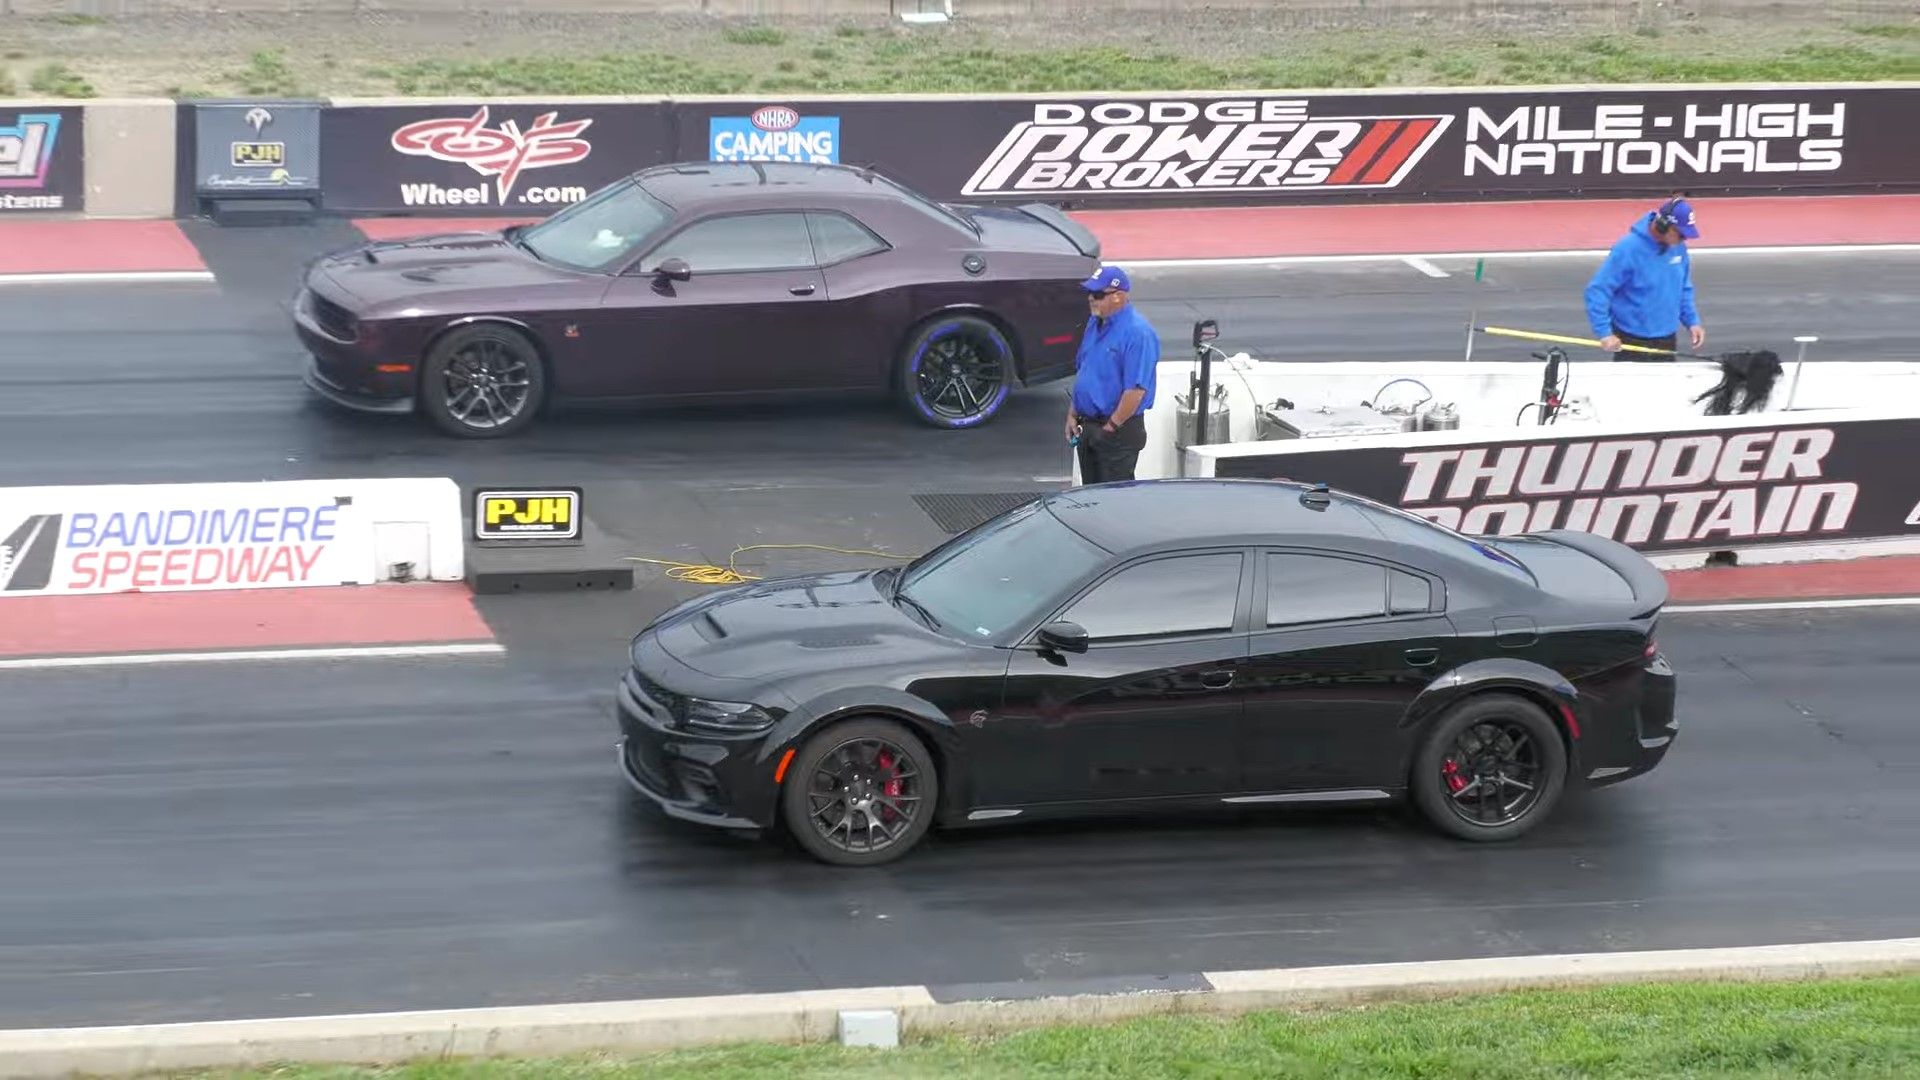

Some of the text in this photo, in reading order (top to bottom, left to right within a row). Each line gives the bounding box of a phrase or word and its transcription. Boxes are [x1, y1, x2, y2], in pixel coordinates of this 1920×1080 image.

[759, 110, 792, 128] NHRA
[1034, 100, 1309, 125] DODGE
[236, 145, 281, 160] PJH
[715, 131, 832, 155] CAMPING
[1032, 122, 1362, 162] POWER
[1464, 139, 1843, 176] NATIONALS
[1013, 158, 1342, 189] BROKERS
[401, 183, 586, 205] Wheel .com
[1401, 428, 1835, 502] THUNDER
[486, 498, 569, 524] PJH
[66, 505, 339, 548] BANDIMERE
[68, 545, 325, 589] SPEEDWAY
